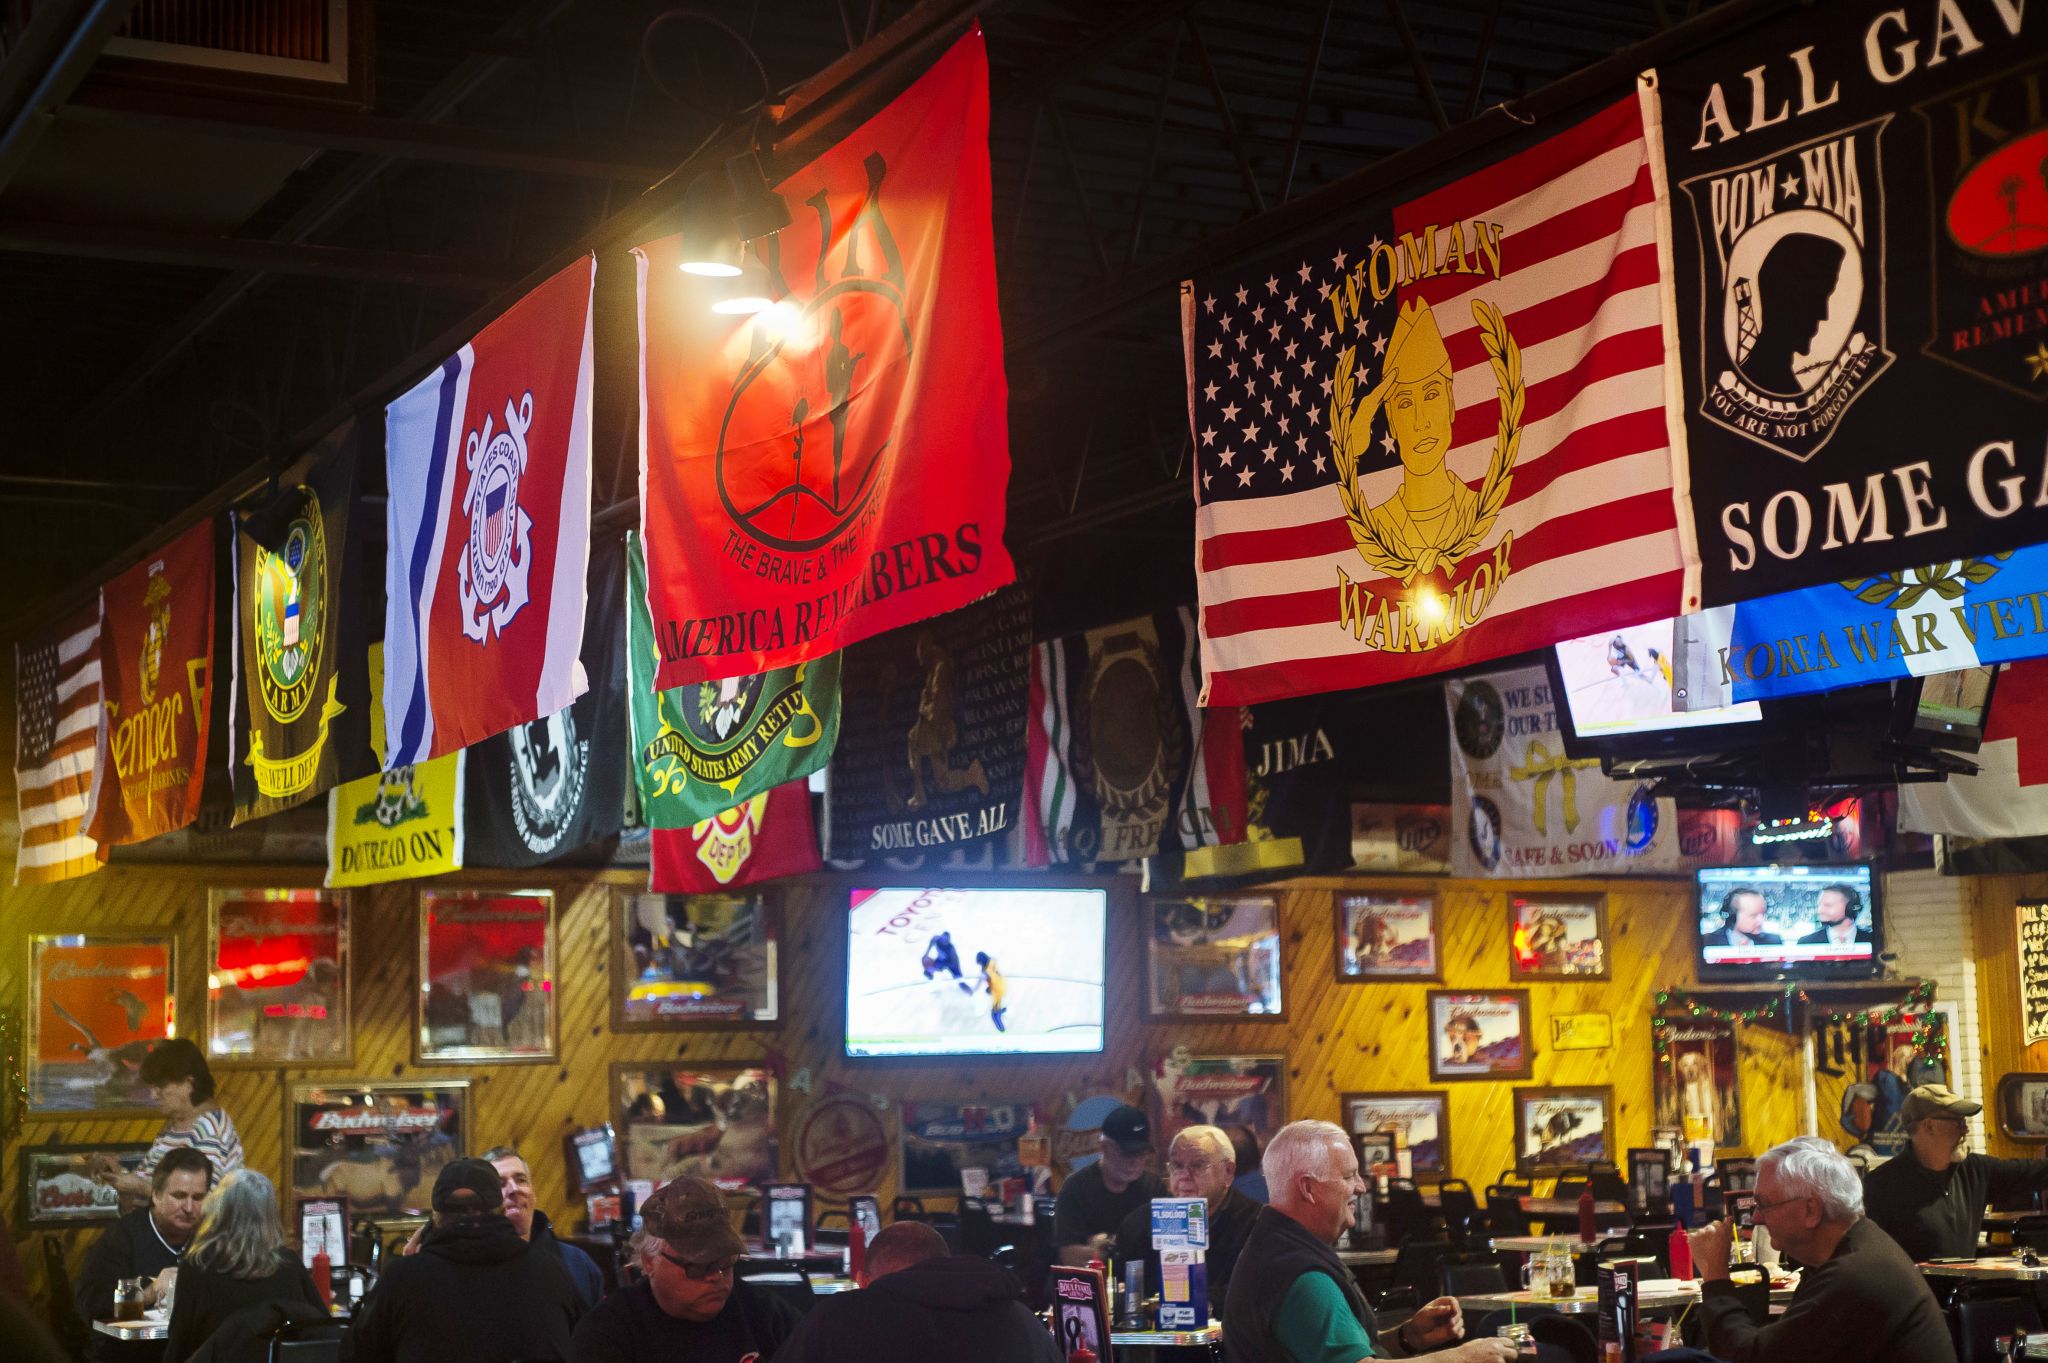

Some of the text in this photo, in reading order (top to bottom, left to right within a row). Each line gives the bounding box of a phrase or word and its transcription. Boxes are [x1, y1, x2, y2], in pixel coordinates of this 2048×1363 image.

[1692, 45, 1839, 150] ALL
[1710, 135, 1865, 291] POW MIA
[1329, 220, 1504, 334] WOMAN
[1710, 341, 1878, 439] YOU ARE NOT FORGOTTEN
[472, 440, 520, 591] UNITED STATES COAST GUARD
[1721, 461, 1948, 572] SOME
[720, 528, 754, 570] THE
[756, 555, 813, 585] BRAVE
[817, 554, 827, 580] &
[830, 525, 858, 570] THE
[483, 574, 499, 597] 1790
[1716, 631, 1839, 686] KOREA
[1842, 613, 1949, 663] WAR
[271, 676, 308, 712] ARMY
[1508, 713, 1542, 737] OUR
[650, 734, 691, 762] UNITED
[691, 753, 727, 780] STATES
[727, 736, 760, 776] ARMY
[1257, 728, 1335, 777] JIMA
[410, 829, 442, 863] ON
[871, 802, 1008, 850] SOME GAVE ALL
[1567, 838, 1620, 864] SOON
[316, 1109, 439, 1131] Budweiser
